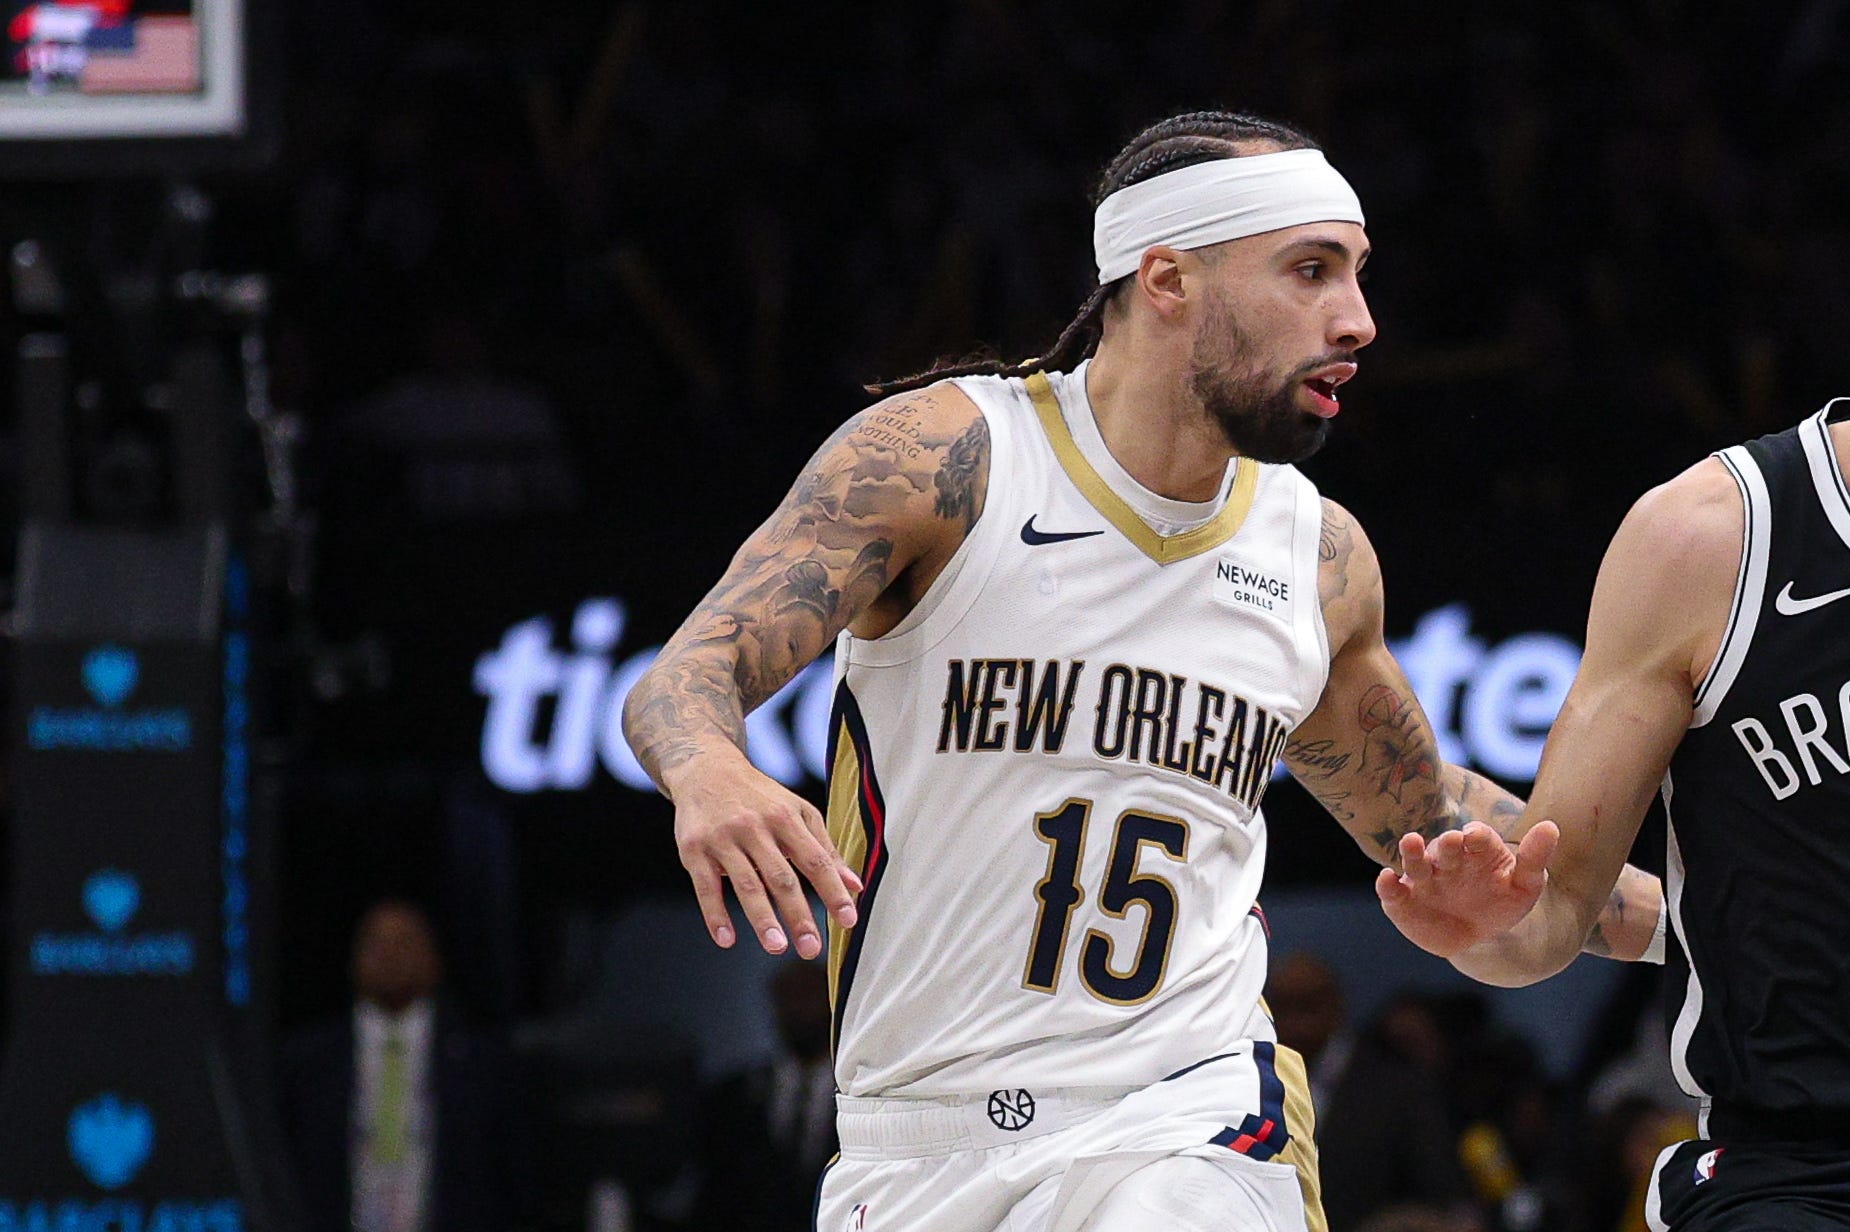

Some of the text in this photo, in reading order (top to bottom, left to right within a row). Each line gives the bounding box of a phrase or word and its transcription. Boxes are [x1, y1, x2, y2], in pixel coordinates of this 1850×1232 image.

[1217, 560, 1288, 601] NEWAGE
[1233, 590, 1274, 610] GRILLS
[936, 658, 1085, 753] NEW
[1021, 796, 1190, 1006] 15
